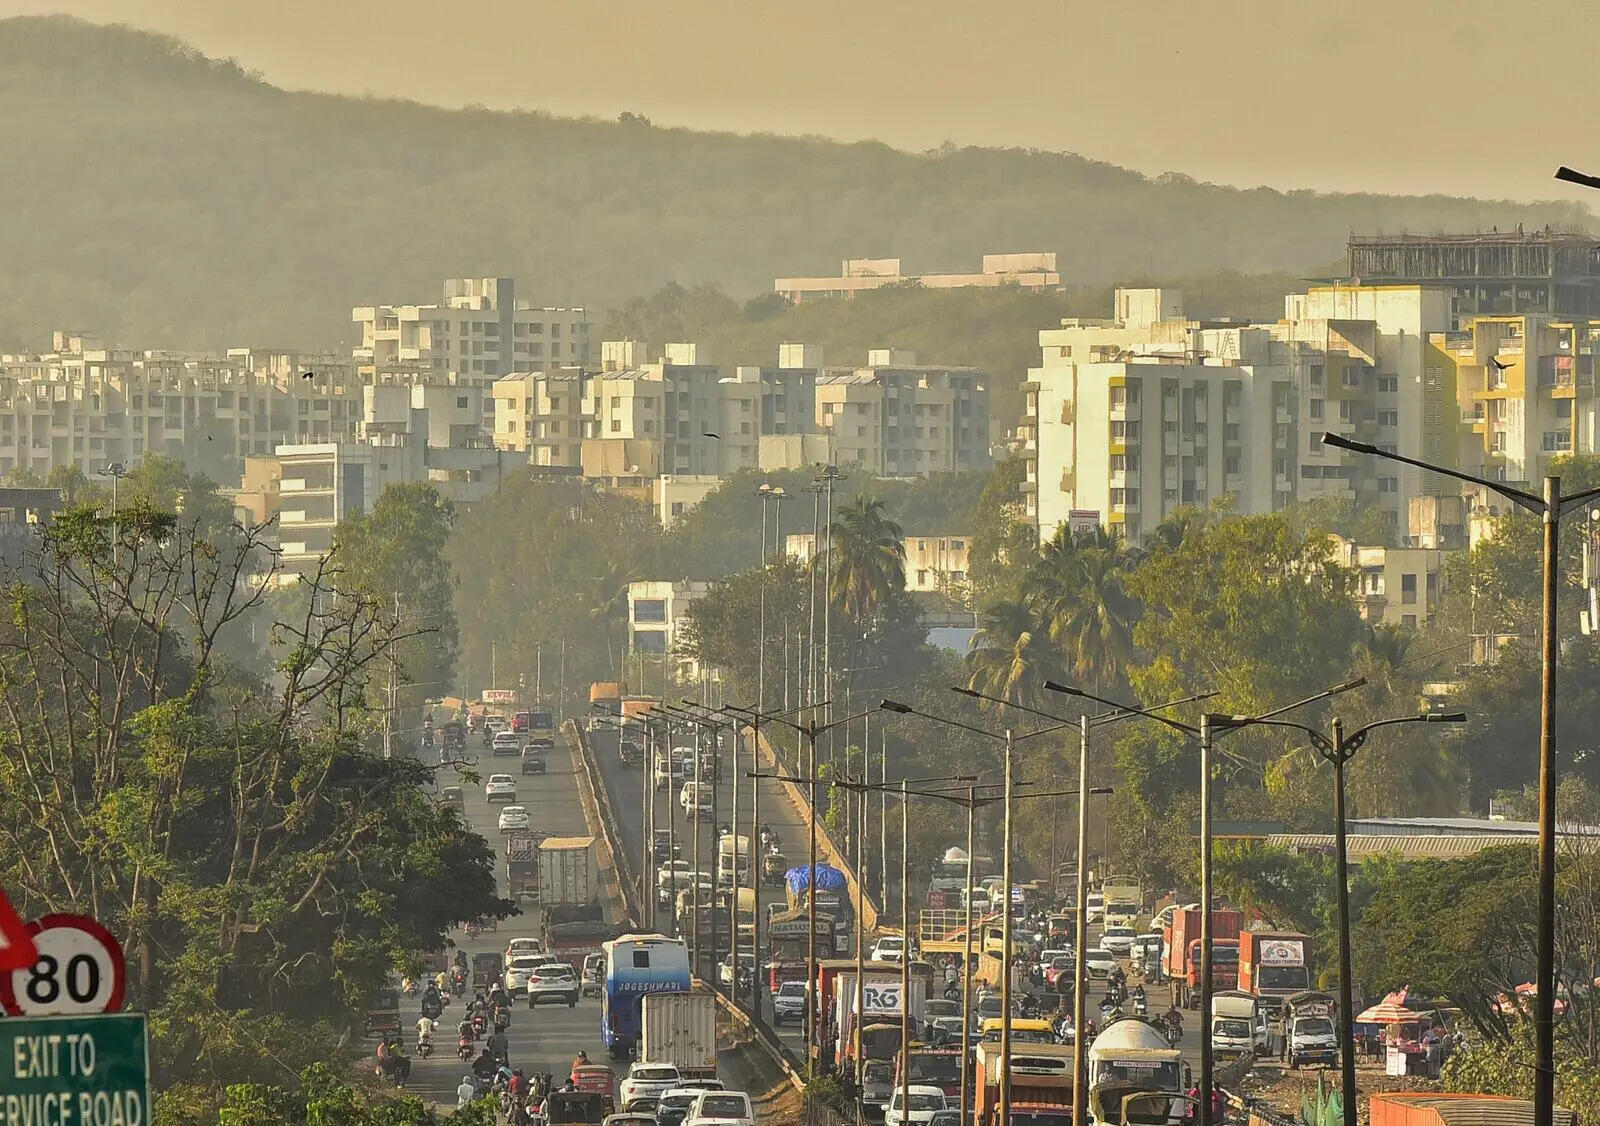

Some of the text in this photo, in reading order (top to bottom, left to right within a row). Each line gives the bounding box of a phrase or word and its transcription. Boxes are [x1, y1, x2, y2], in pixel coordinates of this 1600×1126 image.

[27, 954, 99, 1003] 80
[618, 982, 680, 991] JOGESHWARI
[864, 988, 899, 1008] RG
[14, 1032, 96, 1078] EXIT TO
[79, 1090, 142, 1126] ROAD
